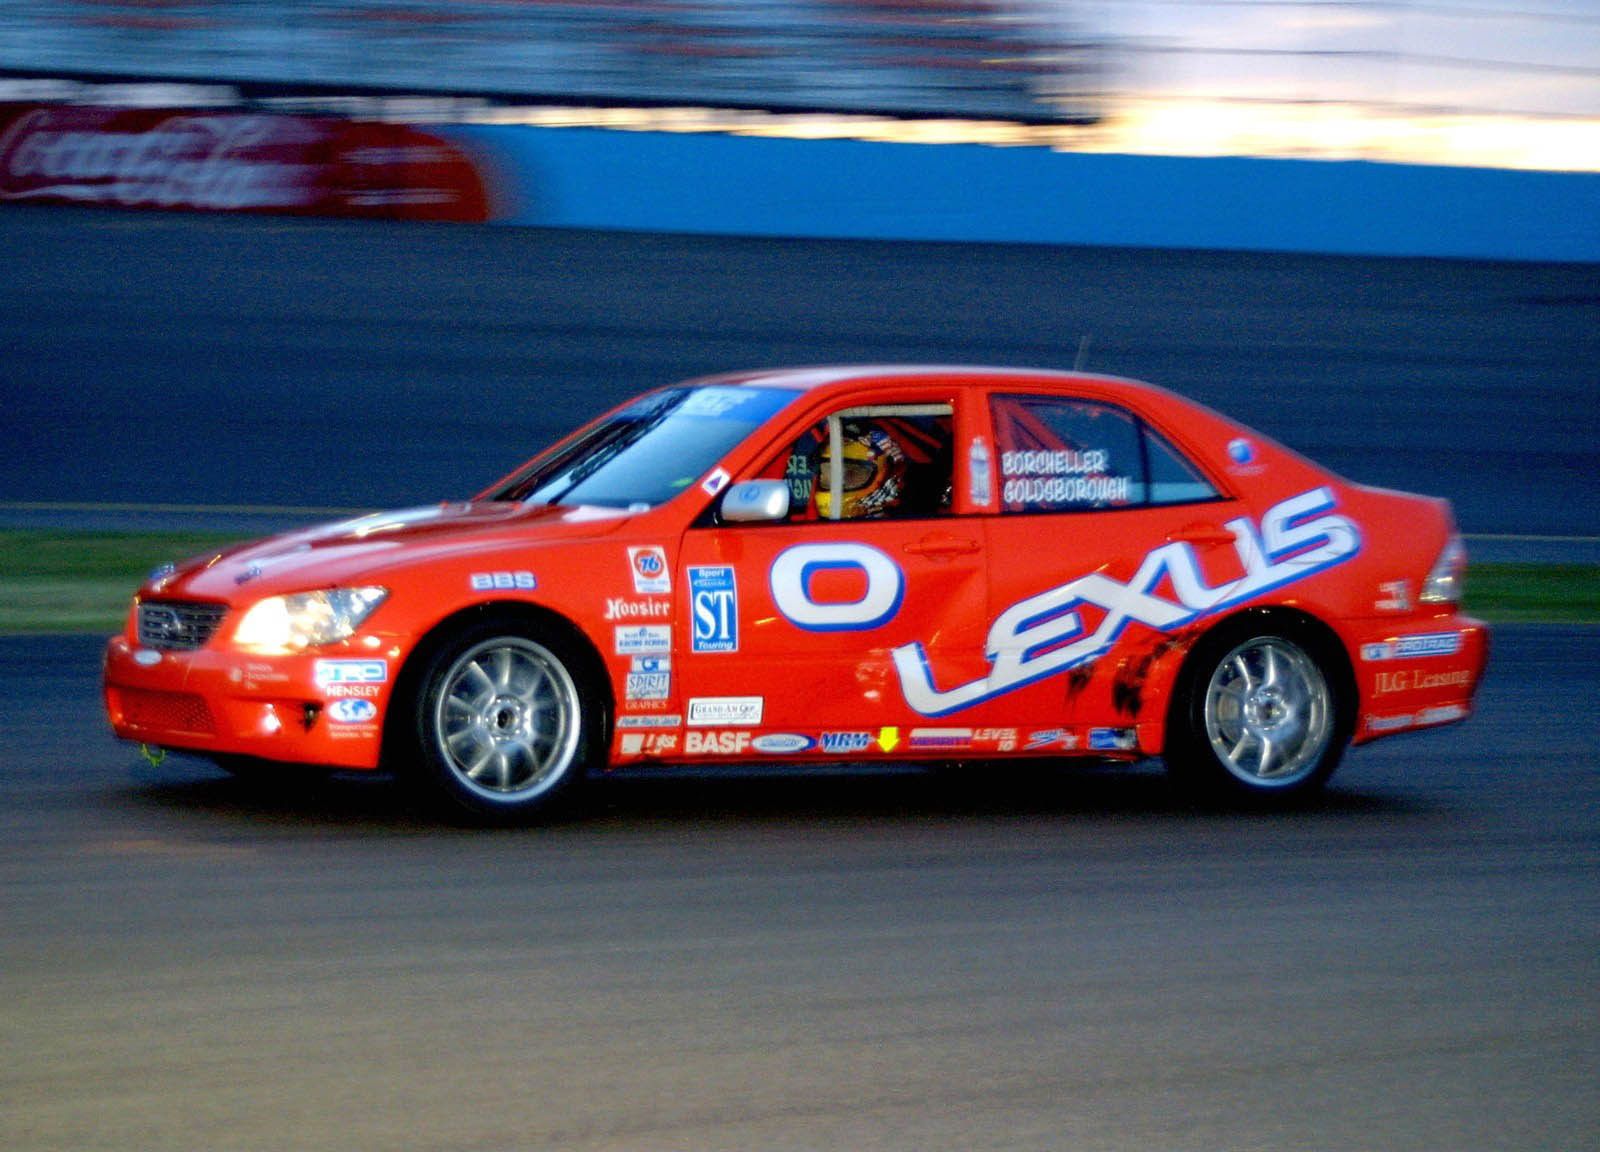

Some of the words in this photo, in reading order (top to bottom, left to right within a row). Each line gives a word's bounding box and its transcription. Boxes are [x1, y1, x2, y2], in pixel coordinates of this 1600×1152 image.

[1002, 450, 1108, 475] BORCHELLER
[1003, 476, 1129, 503] GOLDSBOROUGH
[639, 556, 660, 573] 76
[698, 569, 725, 578] Sport
[470, 570, 537, 590] BBS
[603, 595, 671, 620] Hoosier
[892, 487, 1363, 718] LEXUS
[695, 590, 735, 640] ST
[698, 640, 735, 650] Touring
[629, 673, 667, 689] SPIRIT
[1413, 669, 1471, 689] Leasing
[326, 685, 380, 697] HENSLEY
[685, 732, 751, 753] BASF
[973, 727, 1017, 740] LEVEL
